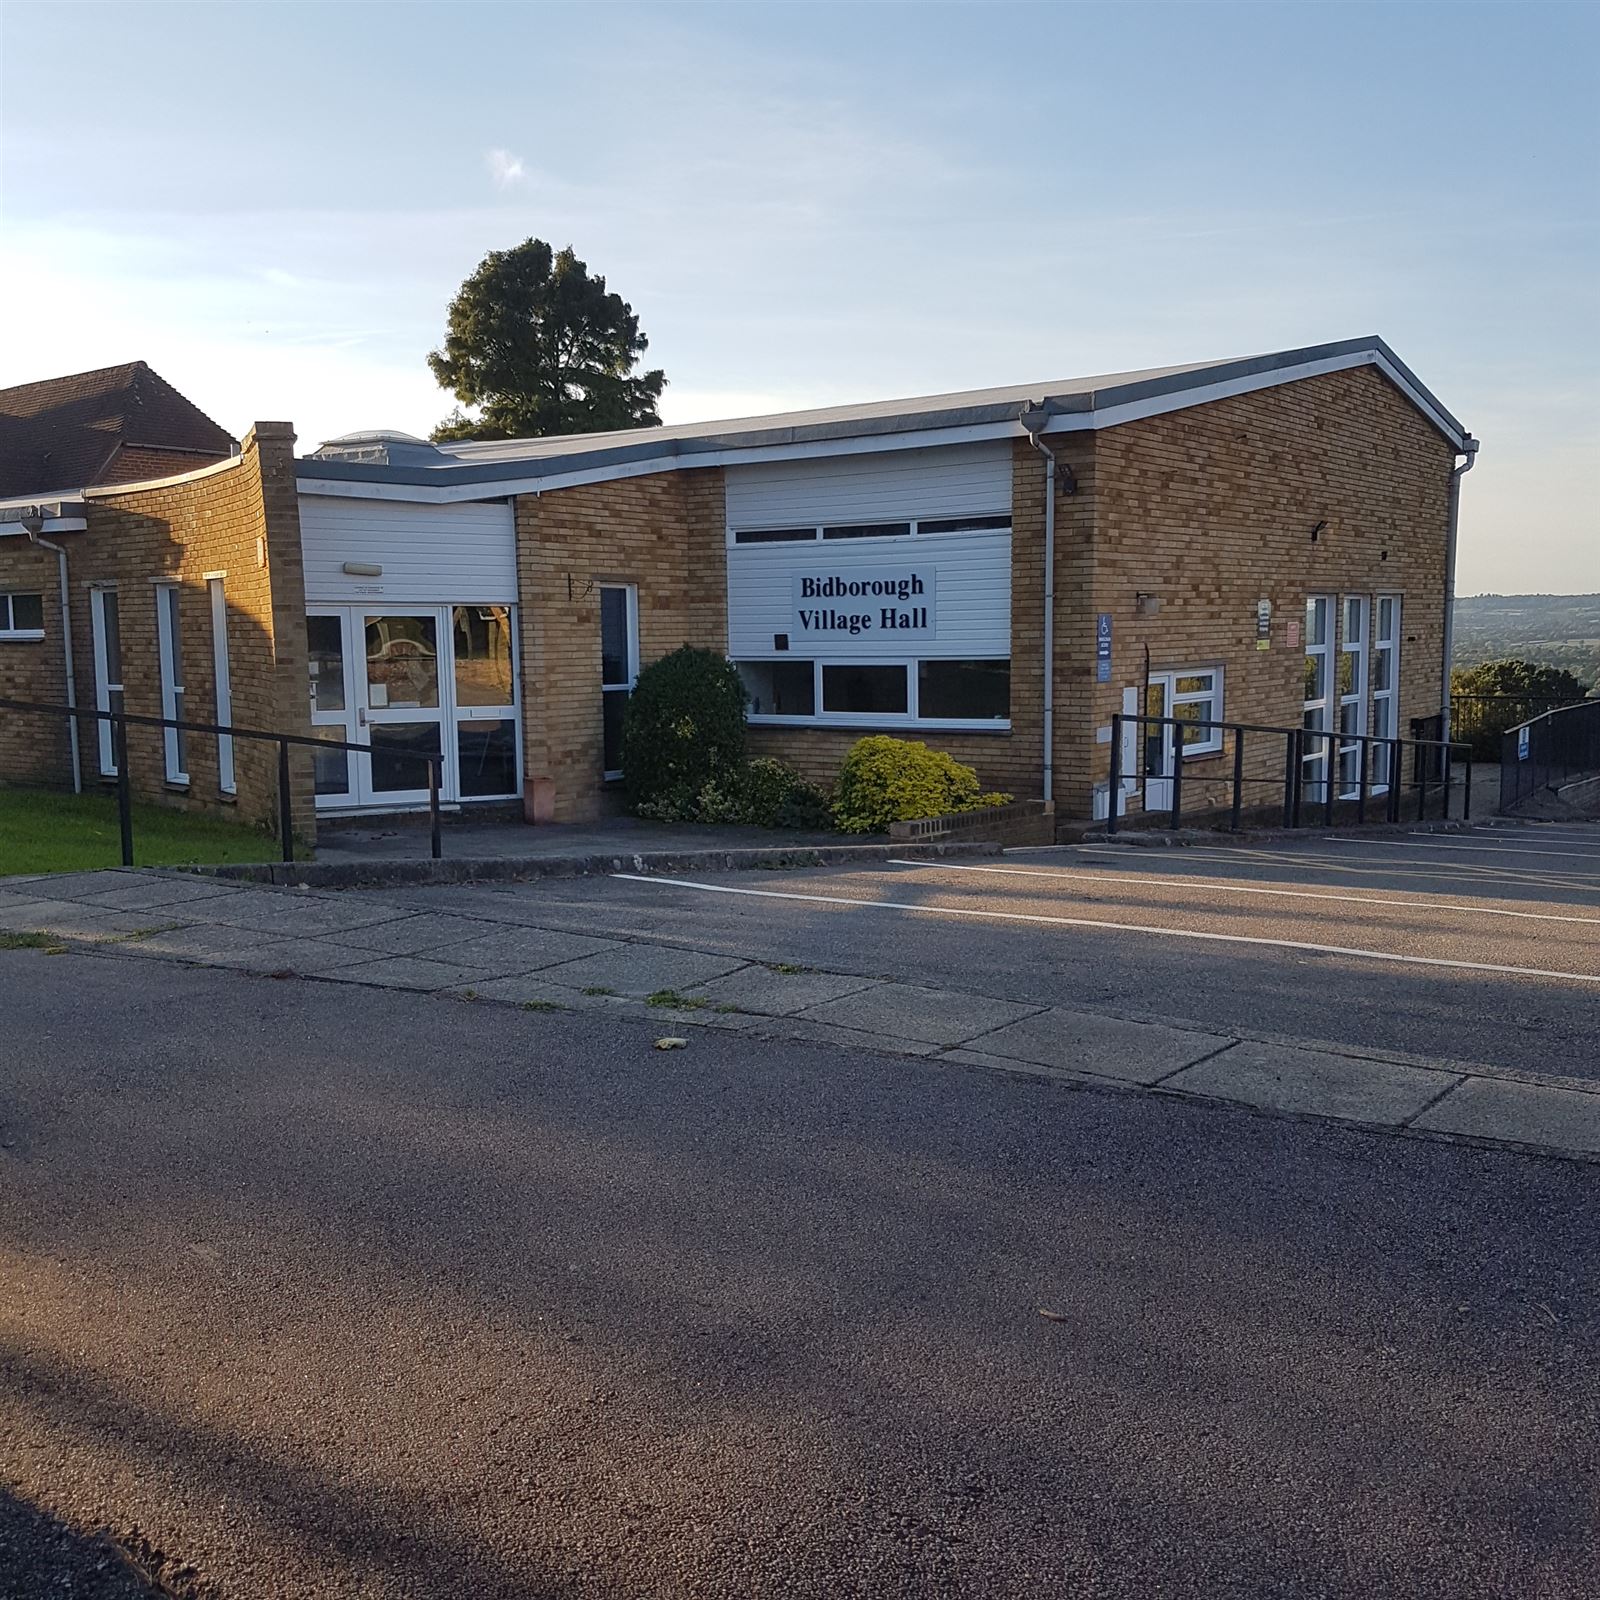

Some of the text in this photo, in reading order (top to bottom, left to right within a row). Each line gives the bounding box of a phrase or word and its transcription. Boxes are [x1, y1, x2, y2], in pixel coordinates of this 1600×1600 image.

[800, 573, 924, 600] Bidborough
[798, 607, 928, 635] Village Hall
